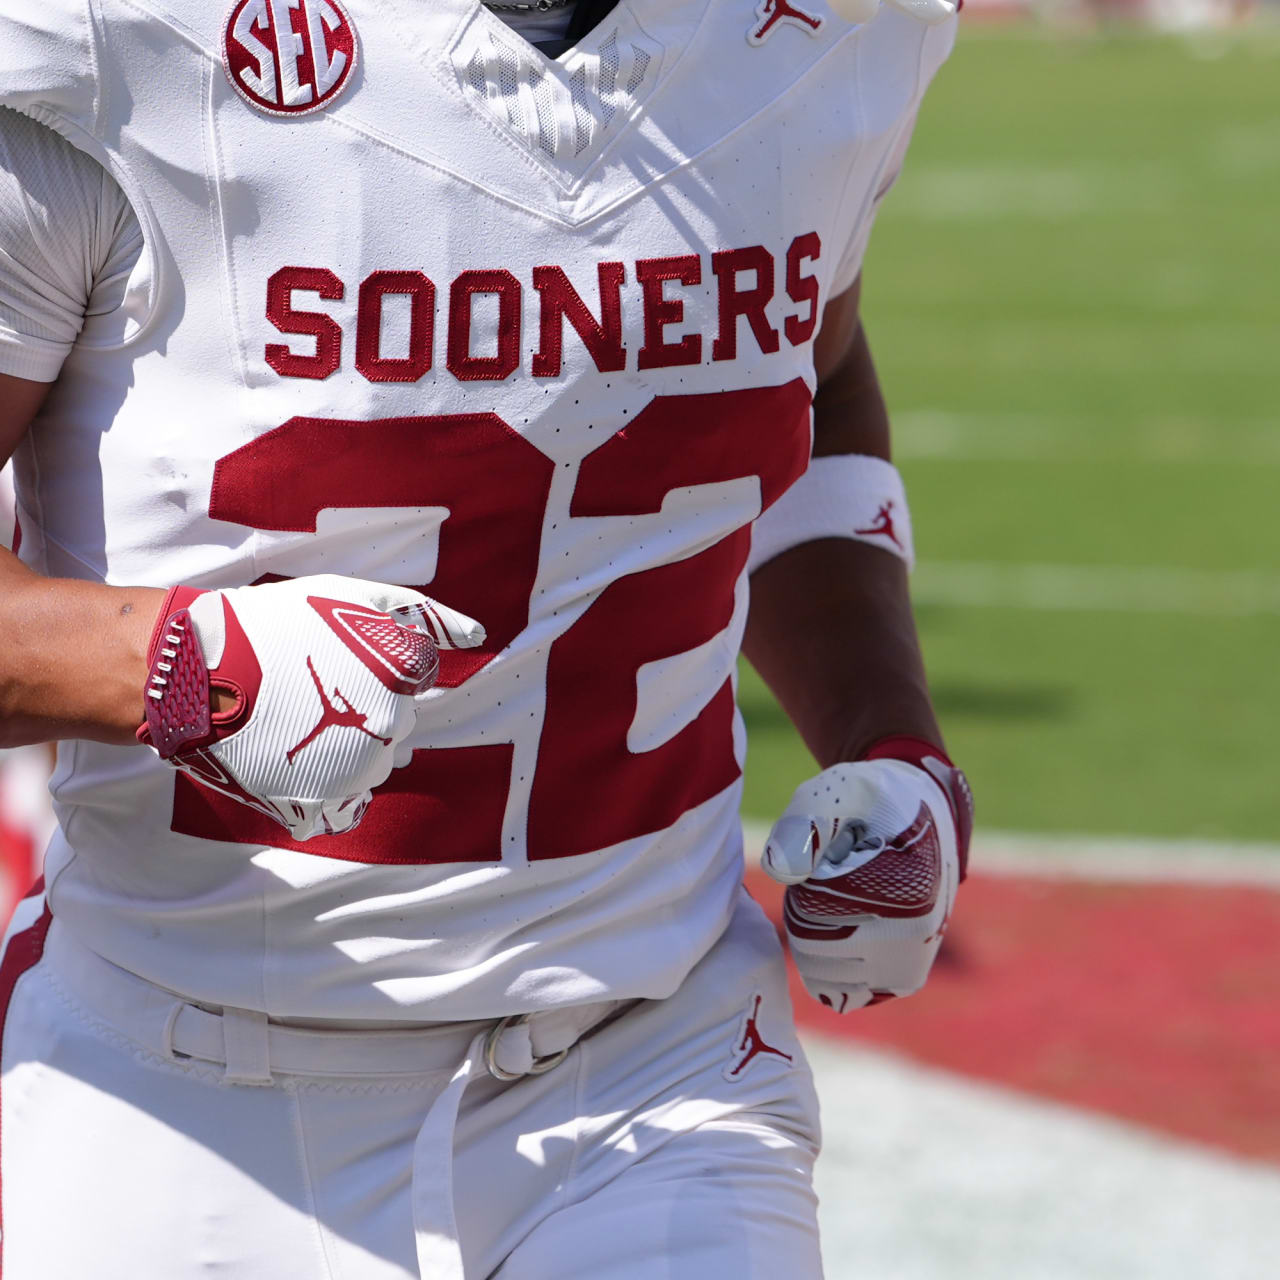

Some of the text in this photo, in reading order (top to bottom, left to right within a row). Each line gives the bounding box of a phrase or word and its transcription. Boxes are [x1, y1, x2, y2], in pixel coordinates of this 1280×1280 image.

[264, 231, 821, 383] SOONERS
[147, 619, 186, 700] JORDAN
[172, 376, 816, 863] 22
